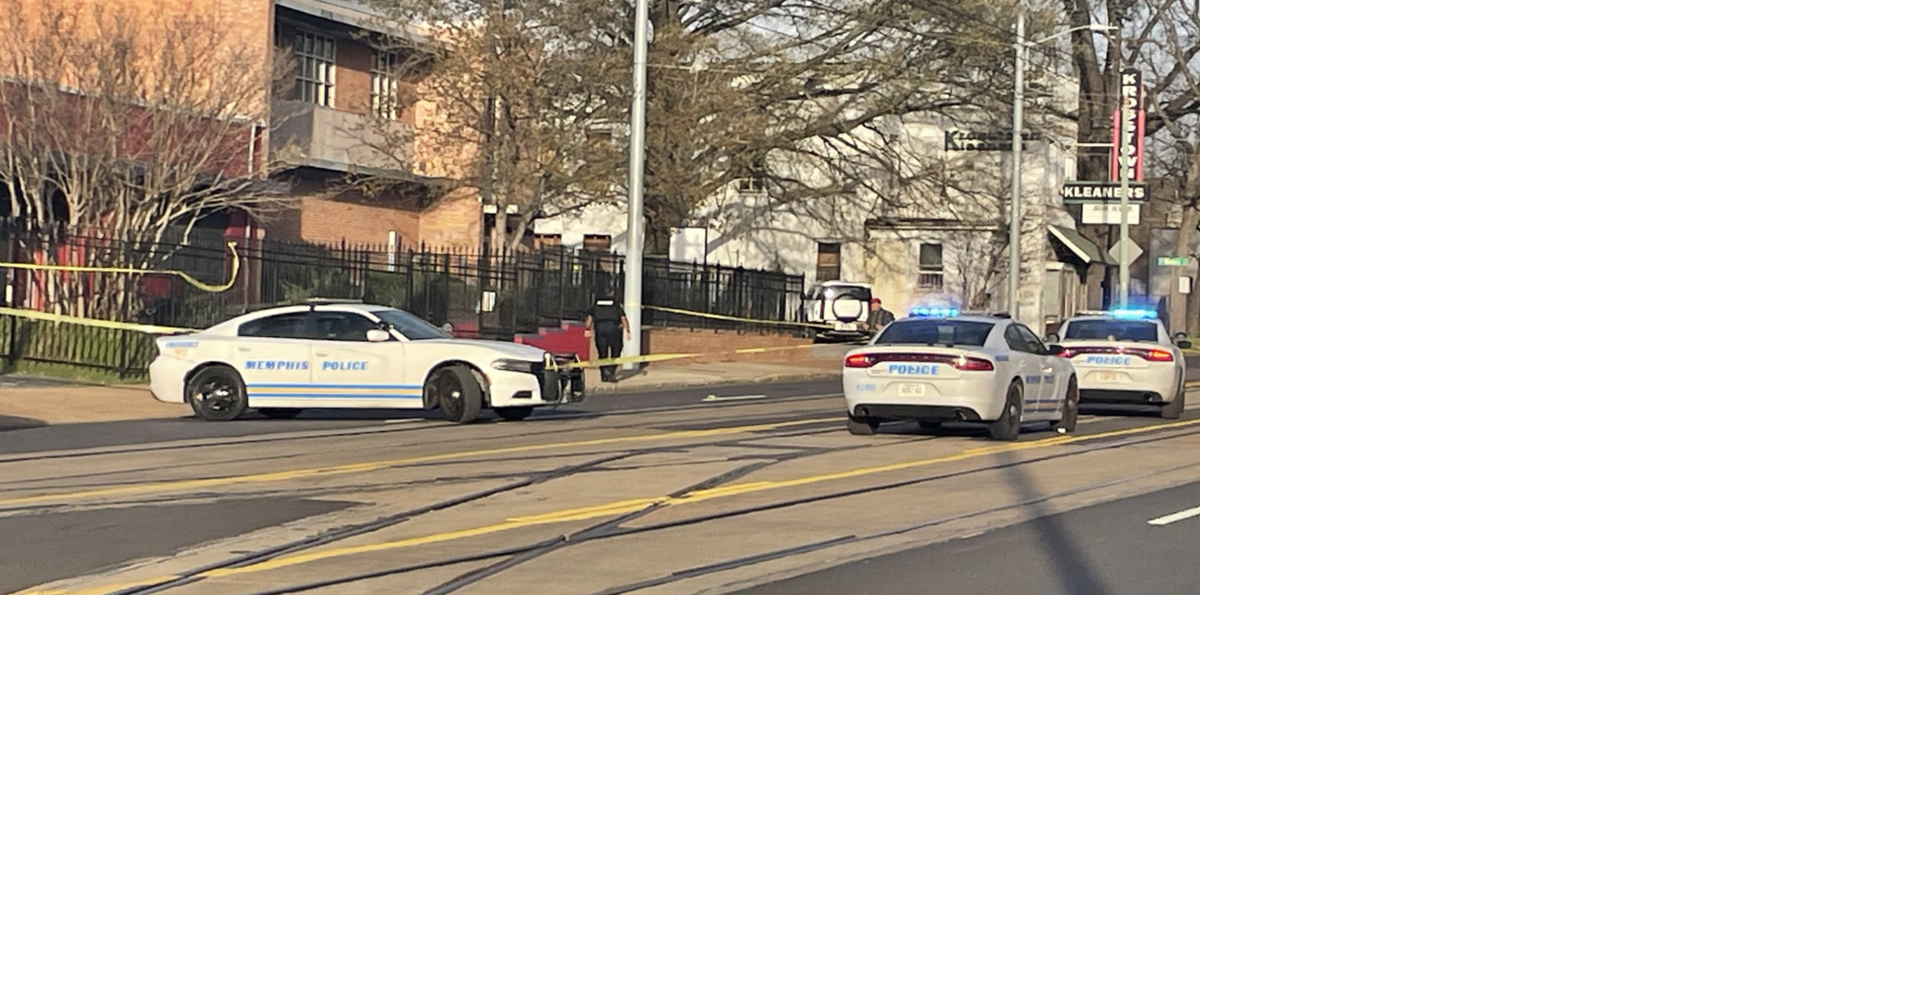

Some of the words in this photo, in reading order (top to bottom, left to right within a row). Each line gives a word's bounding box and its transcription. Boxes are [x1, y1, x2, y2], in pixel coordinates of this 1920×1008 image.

[1064, 186, 1145, 198] KLEANERS
[245, 360, 309, 370] MEMPHIS
[321, 360, 368, 371] POLICE
[1086, 355, 1131, 365] POLICE
[888, 364, 940, 375] POLICE
